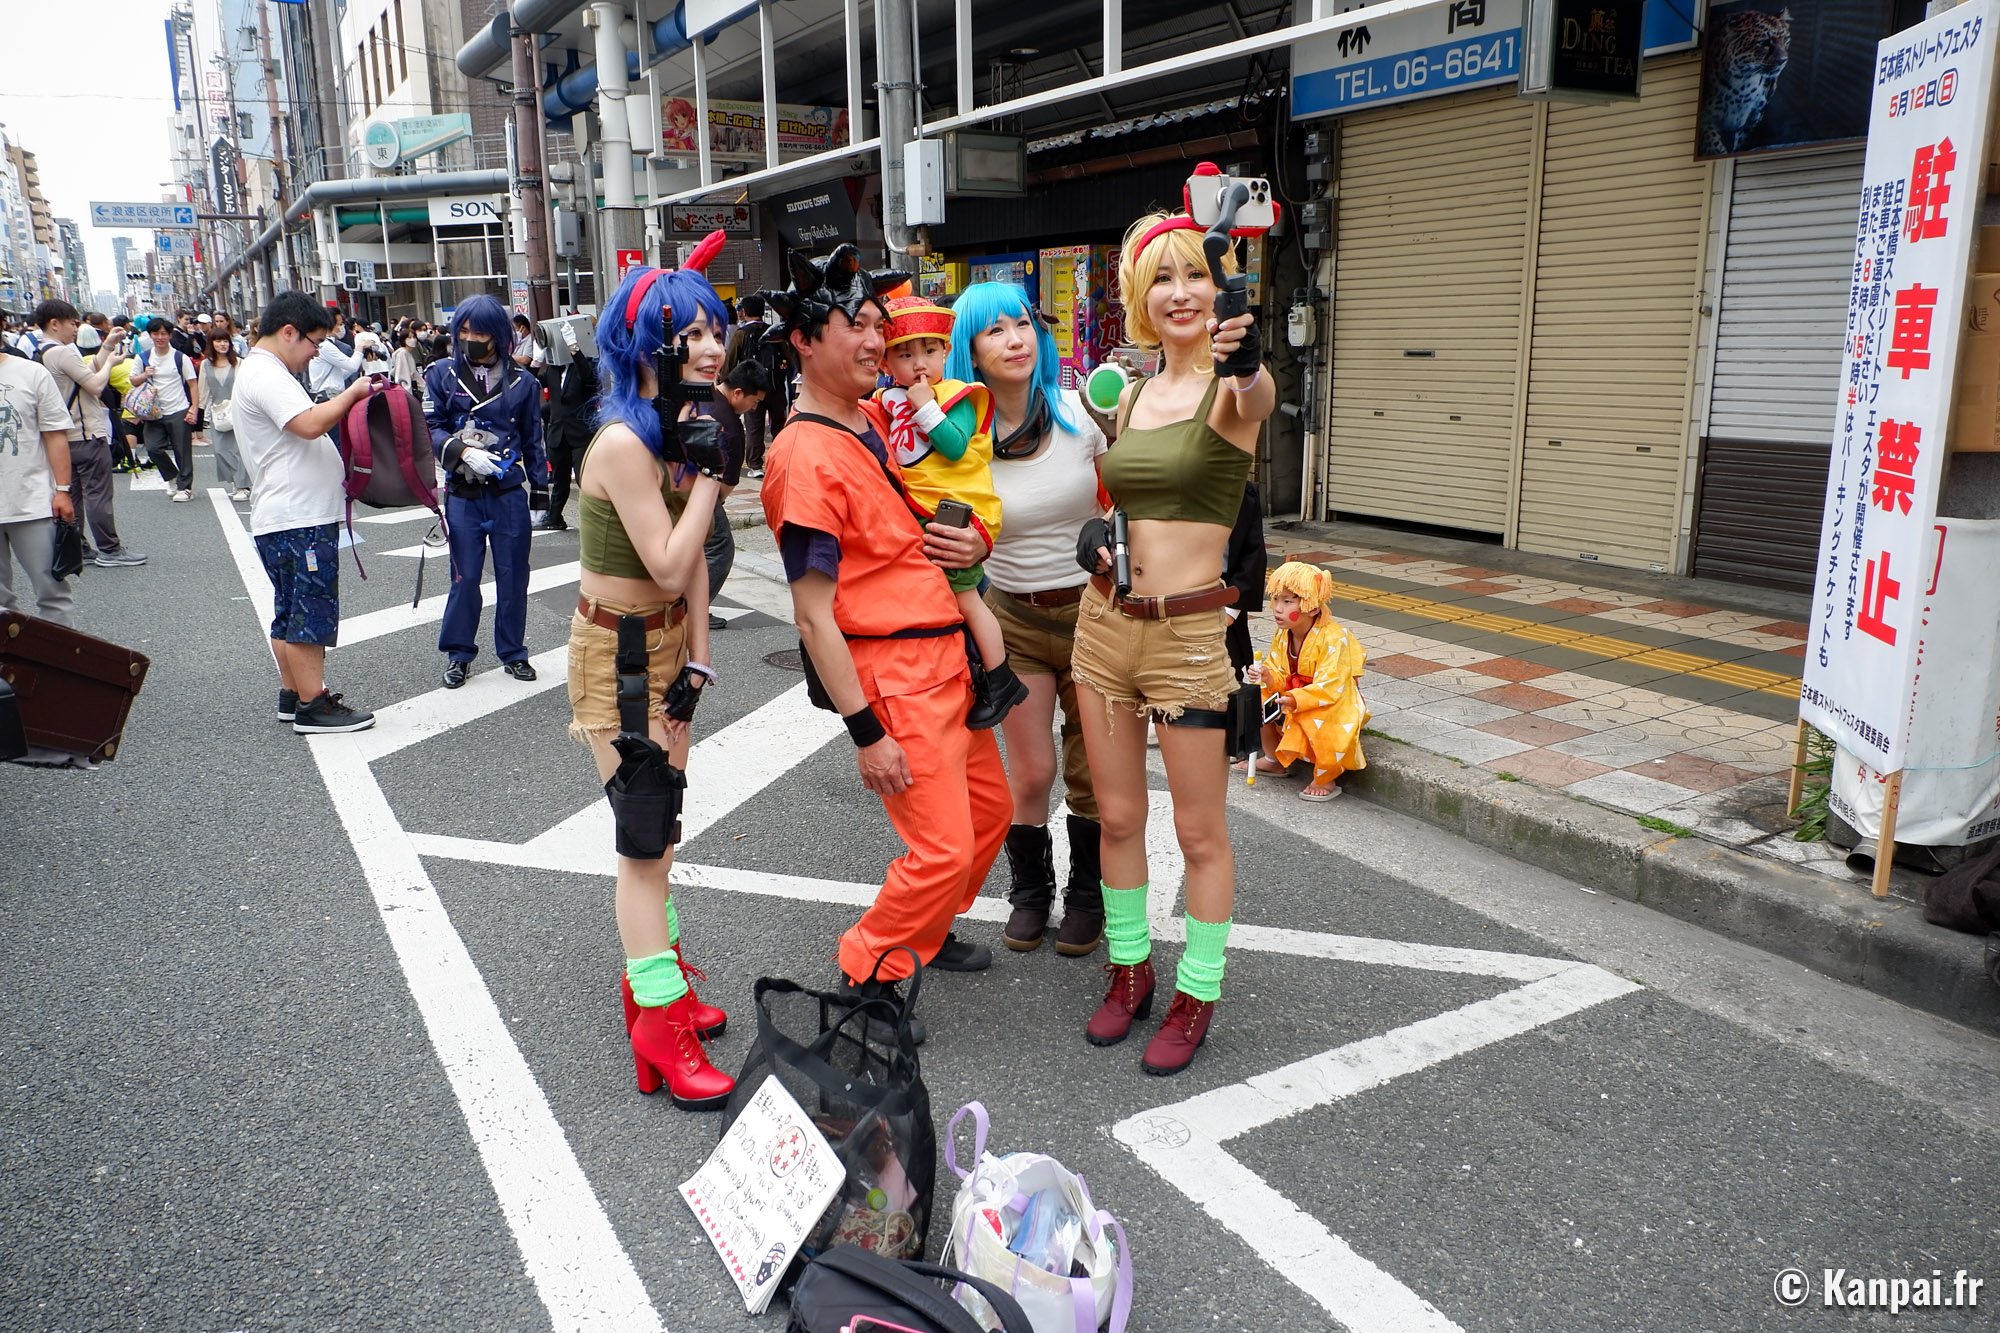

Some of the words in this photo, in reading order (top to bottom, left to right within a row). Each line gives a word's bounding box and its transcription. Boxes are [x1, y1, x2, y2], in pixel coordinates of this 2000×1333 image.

[1335, 66, 1388, 102] TEL.
[1393, 36, 1520, 91] 06-6641
[1561, 17, 1617, 55] DING
[1602, 55, 1635, 76] TEA
[1879, 16, 1982, 85] 日本橋ストリートフェスタ
[377, 147, 388, 160] 東
[111, 206, 172, 217] 浪速区役所
[450, 202, 495, 218] SON
[1844, 186, 1872, 354] 利用できません
[1857, 181, 1895, 402] 駐車ご遠慮ください
[1844, 179, 1906, 641] 日本橋ストリートフェスタが開催されます
[1856, 136, 1958, 648] 駐車禁止
[1802, 683, 1891, 755] 日本橋ストリートフェスタ運営委員会
